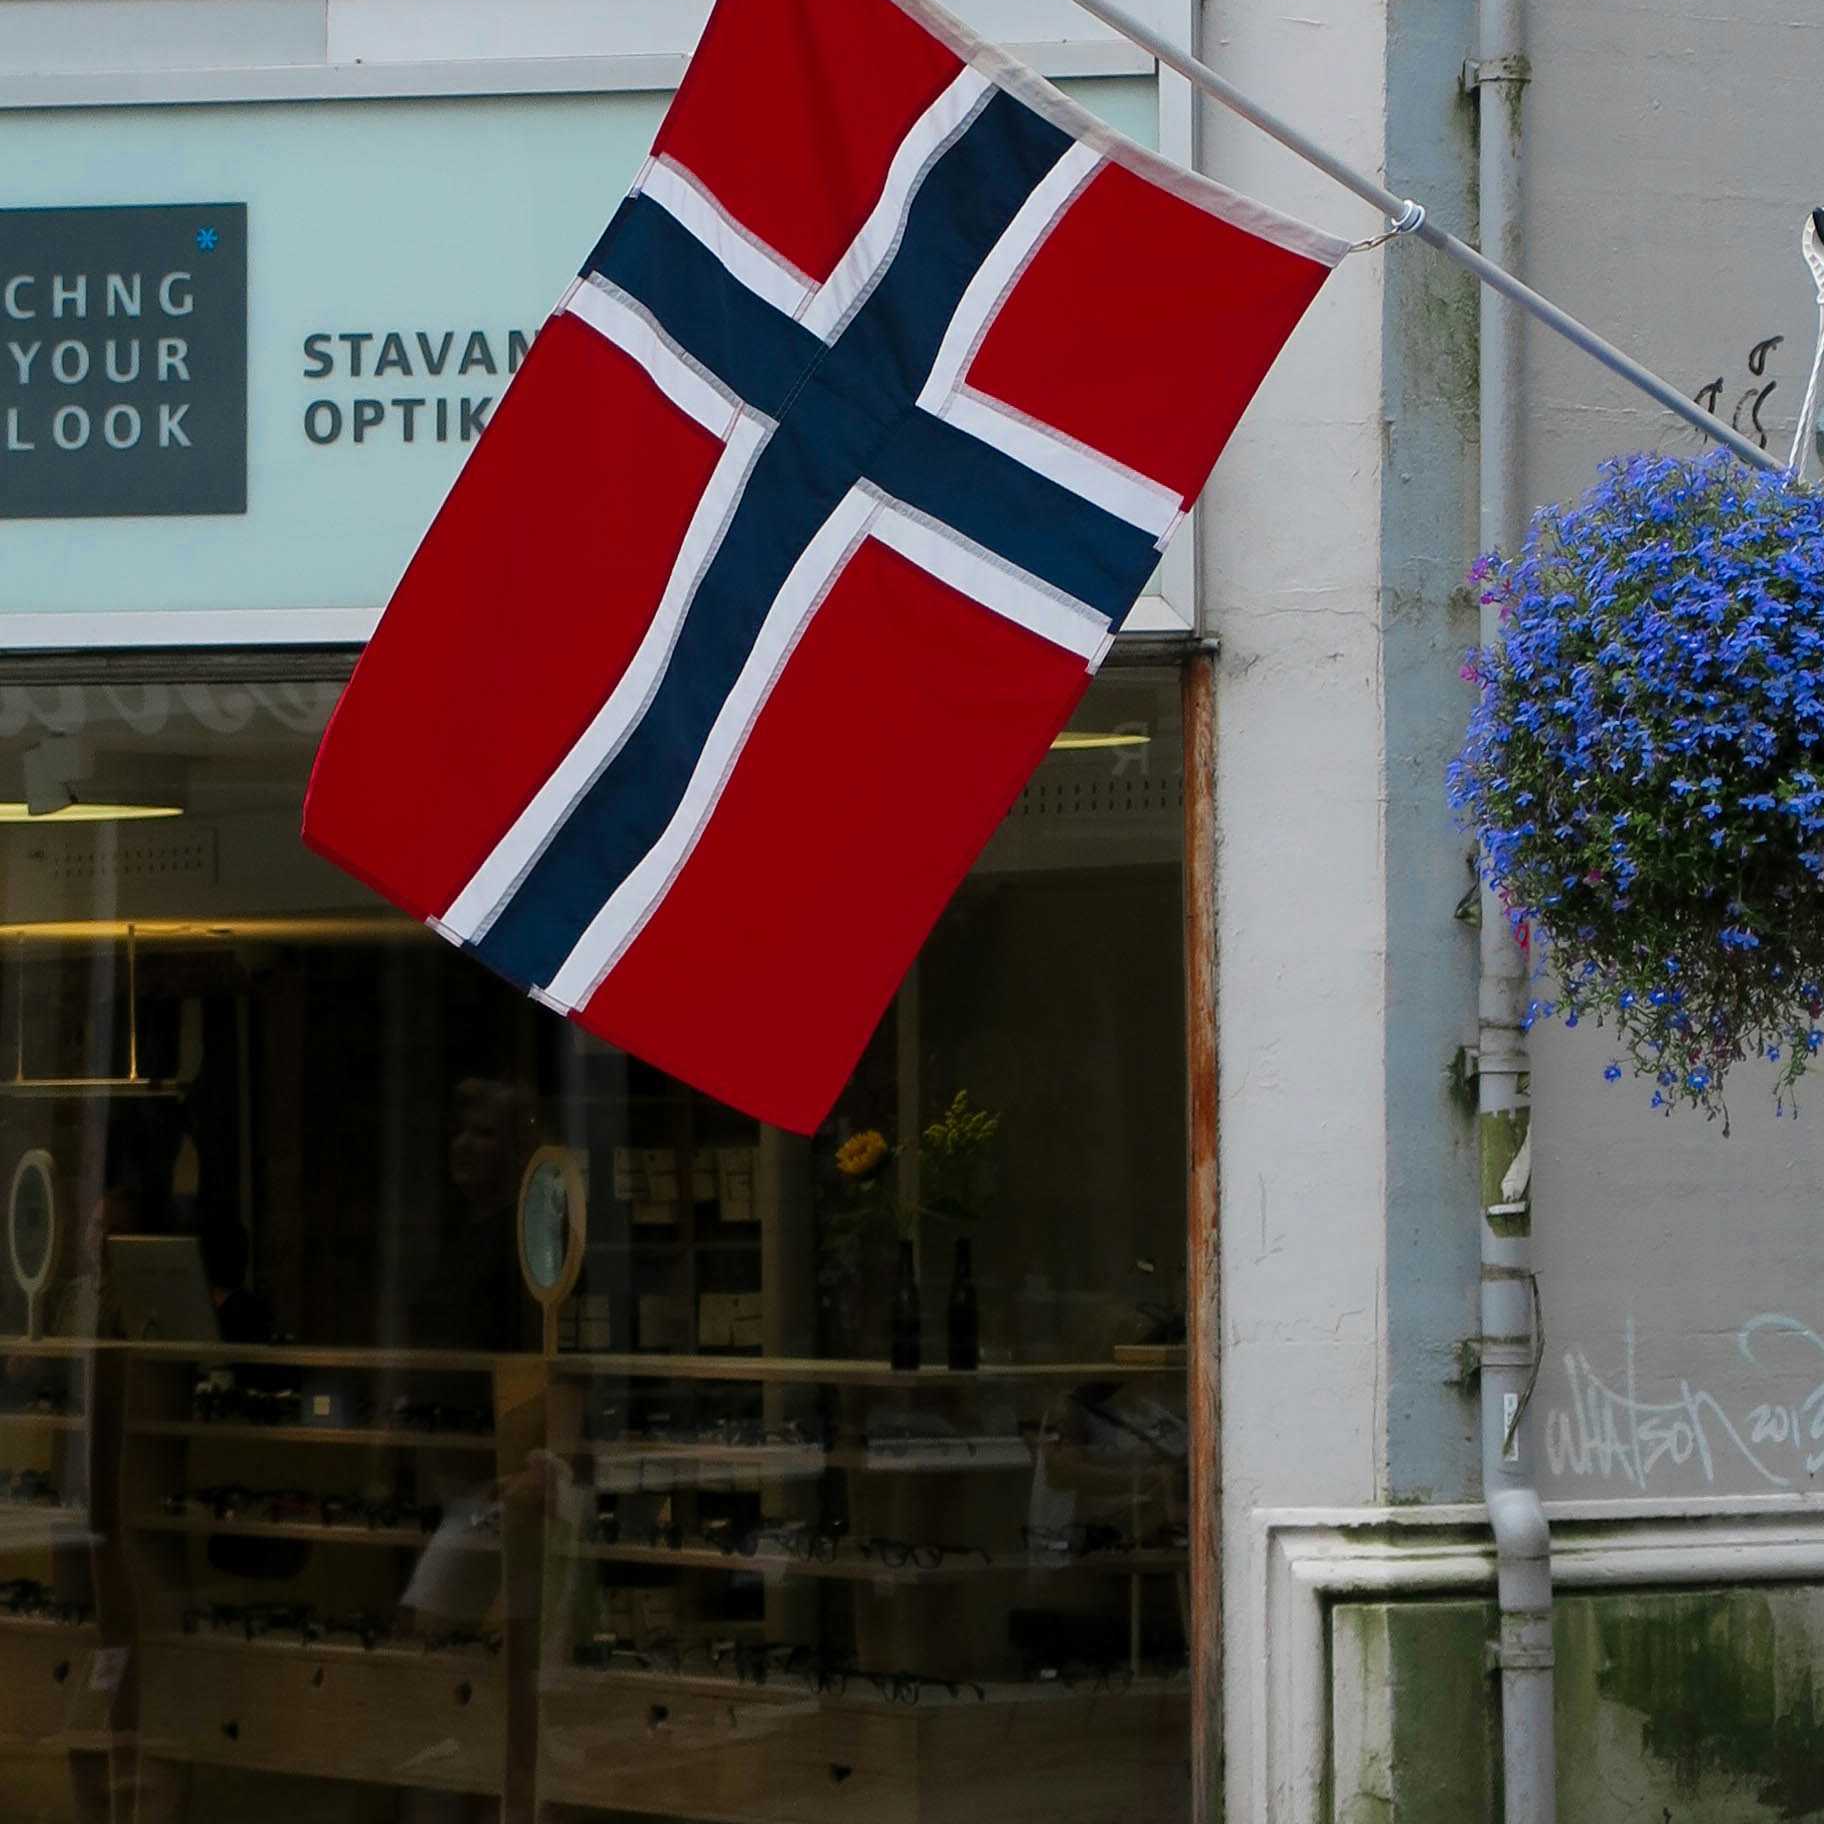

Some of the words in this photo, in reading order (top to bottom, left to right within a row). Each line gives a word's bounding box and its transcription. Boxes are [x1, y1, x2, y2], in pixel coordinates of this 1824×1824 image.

[4, 271, 194, 320] CHNG
[9, 336, 191, 384] YOUR
[7, 402, 193, 451] LOOK
